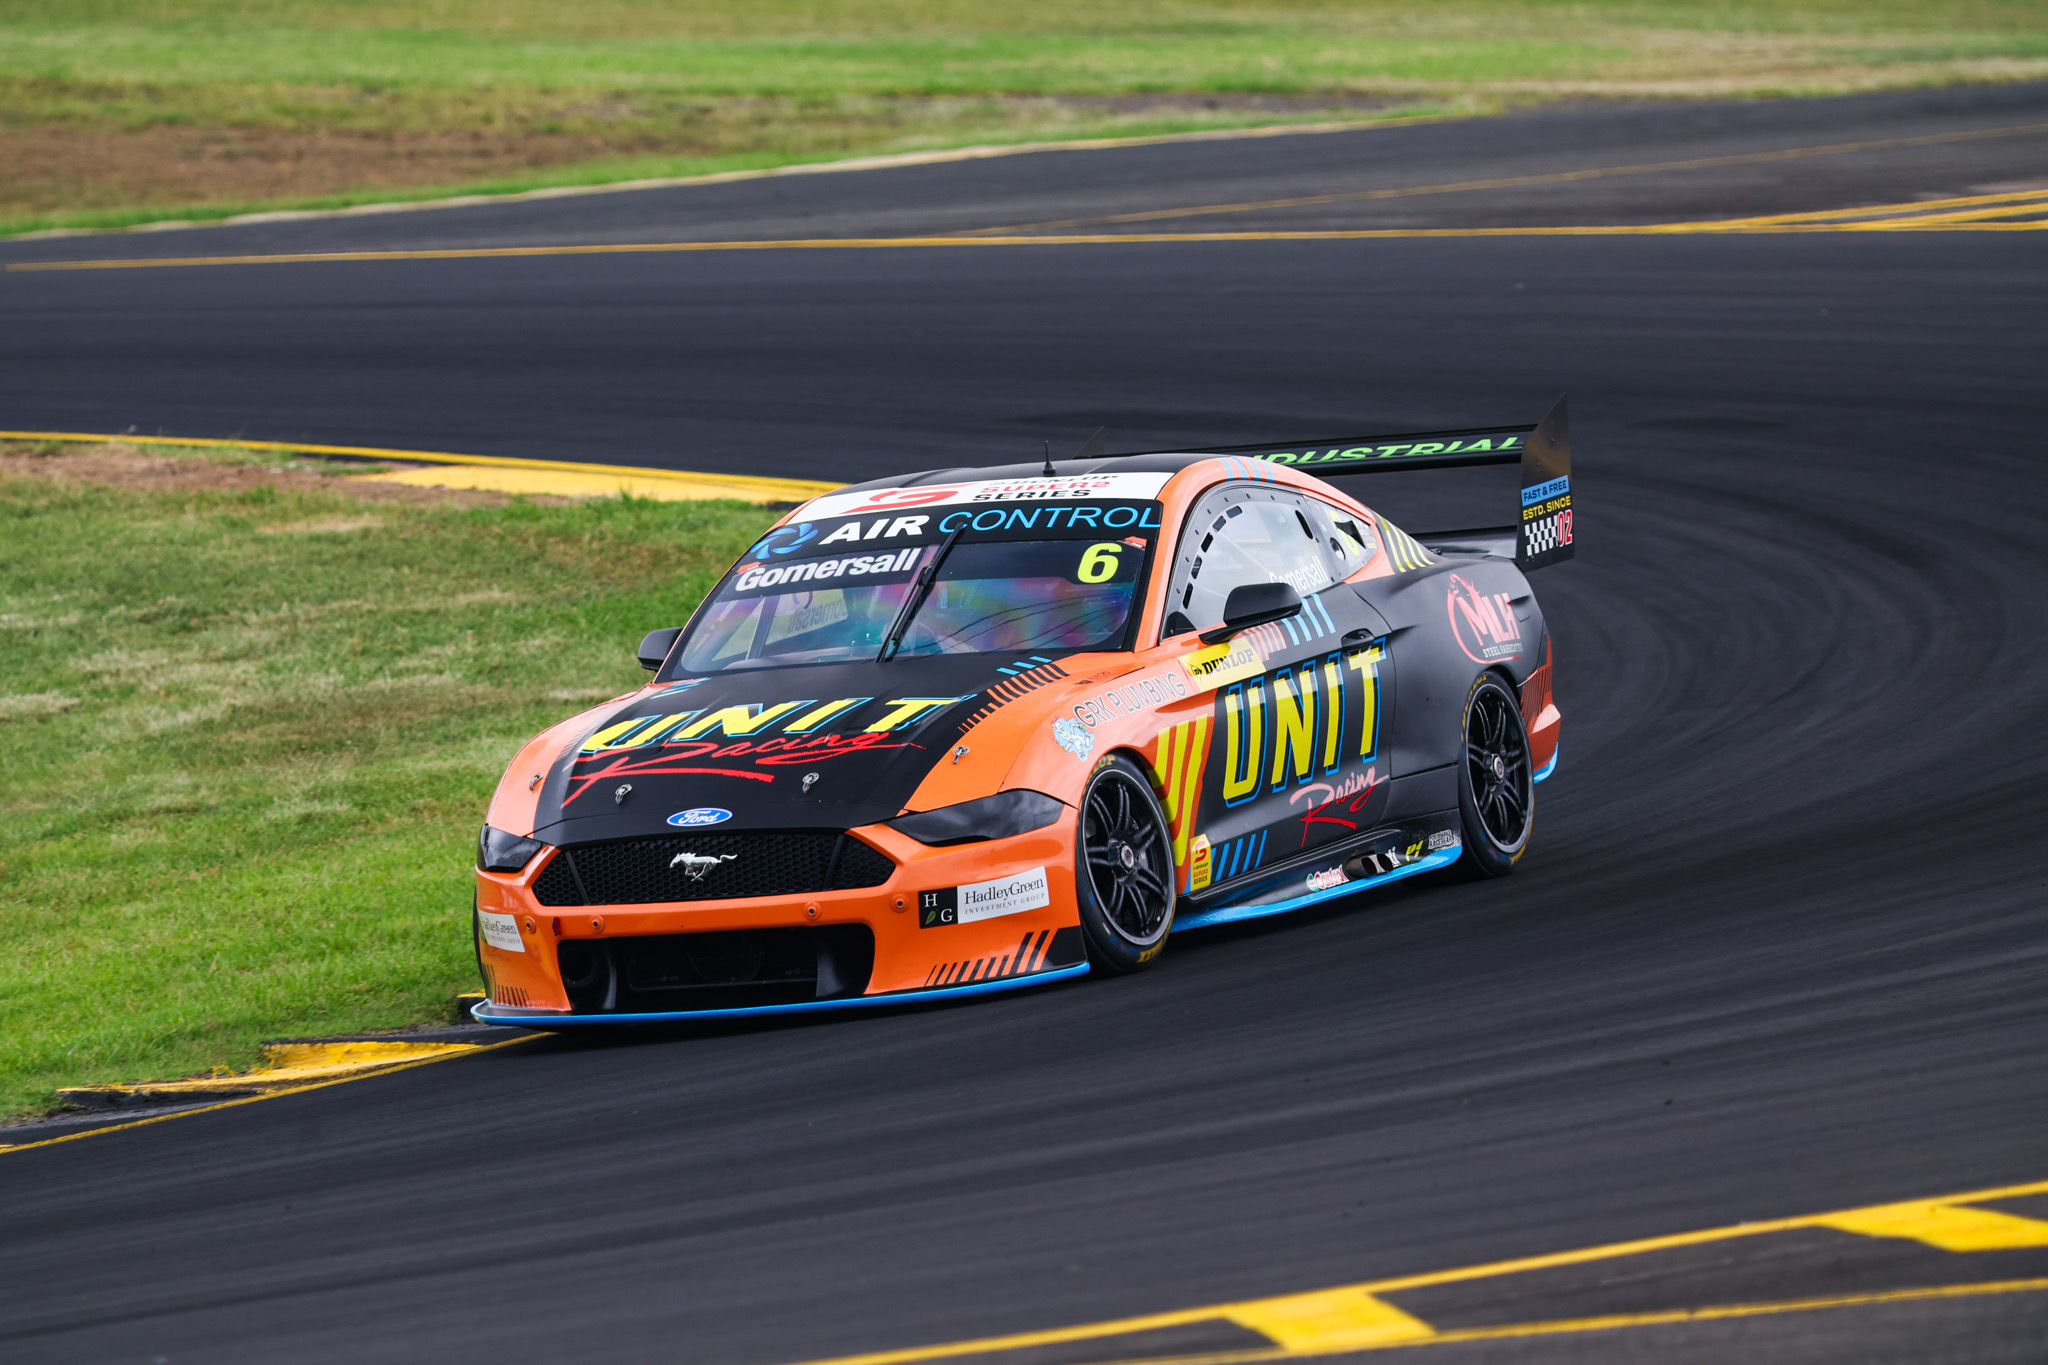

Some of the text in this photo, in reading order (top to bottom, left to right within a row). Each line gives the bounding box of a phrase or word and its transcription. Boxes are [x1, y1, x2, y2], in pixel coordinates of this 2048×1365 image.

[1252, 436, 1521, 465] DUSTRIAL
[972, 489, 1092, 501] SERIES
[980, 481, 1111, 494] SUPER2
[1523, 479, 1567, 502] FAST & FREE
[1522, 495, 1572, 521] ESTD. SINCE
[818, 506, 1161, 546] AIR CONTROL
[1557, 509, 1573, 548] 02
[735, 547, 922, 592] Gomersall
[1077, 542, 1123, 584] 6
[1201, 649, 1254, 676] DUNLOP
[1482, 646, 1501, 658] STEEL
[1073, 672, 1187, 728] GRK PLUMBING
[576, 697, 963, 754] UNIT
[1223, 639, 1386, 808] UNIT
[561, 731, 927, 809] Racing
[678, 810, 721, 824] Ford
[1289, 766, 1389, 848] Racing
[924, 893, 938, 908] H
[964, 878, 1044, 905] HadleyGreen
[965, 893, 1045, 914] INVESTMENT GROUP
[940, 908, 954, 923] G
